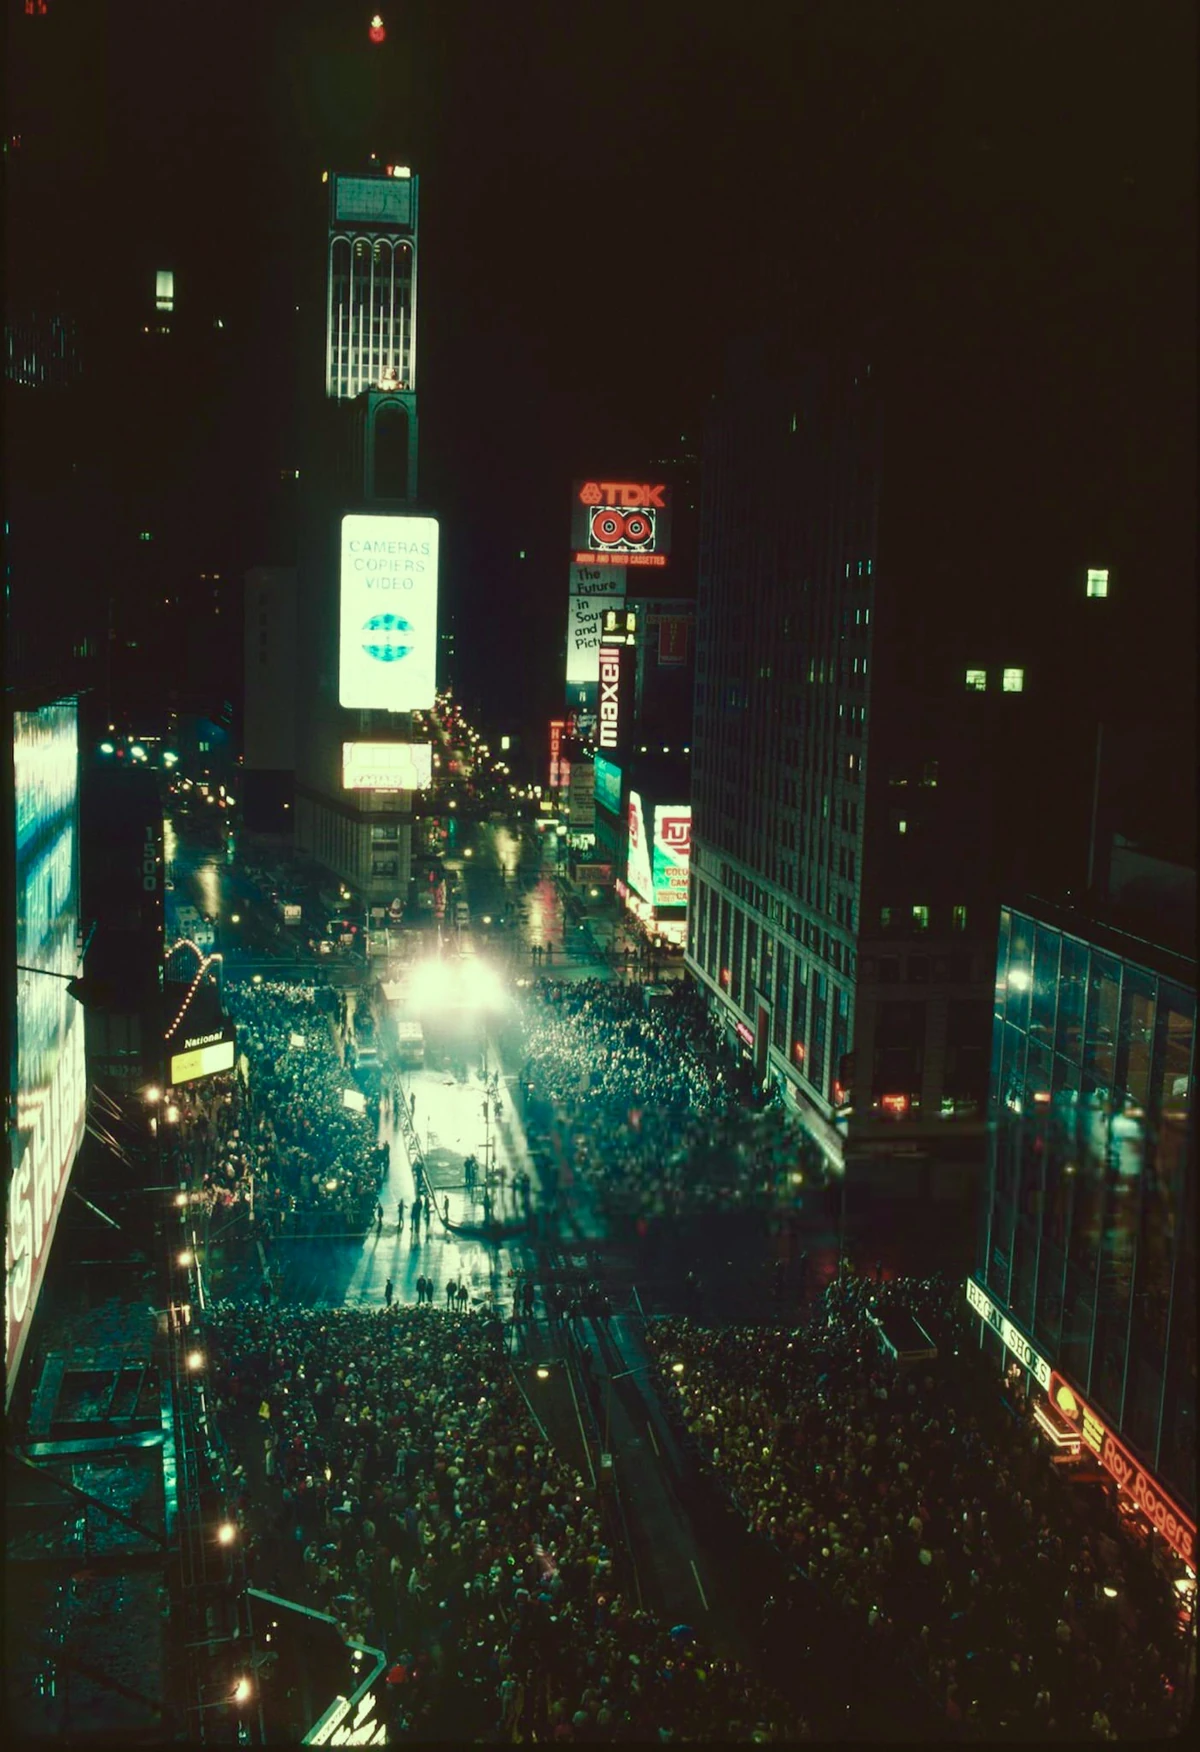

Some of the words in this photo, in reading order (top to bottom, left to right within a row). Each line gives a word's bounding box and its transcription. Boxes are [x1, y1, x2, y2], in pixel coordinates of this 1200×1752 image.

[601, 484, 665, 506] TDK
[349, 540, 431, 556] CAMERAS
[354, 558, 426, 573] COPIERS
[611, 554, 629, 564] VIDEO
[630, 555, 665, 565] CASSETTES
[578, 567, 600, 580] The
[366, 577, 414, 590] VIDEO
[577, 582, 617, 594] Future
[576, 599, 589, 610] in
[575, 623, 597, 636] and
[599, 648, 620, 748] maxell
[143, 826, 157, 891] 1500
[185, 1032, 222, 1048] National
[968, 1282, 1004, 1337] REGAL
[1009, 1329, 1048, 1384] SHOES
[1104, 1438, 1132, 1485] Roy
[1134, 1475, 1192, 1557] Rogers
